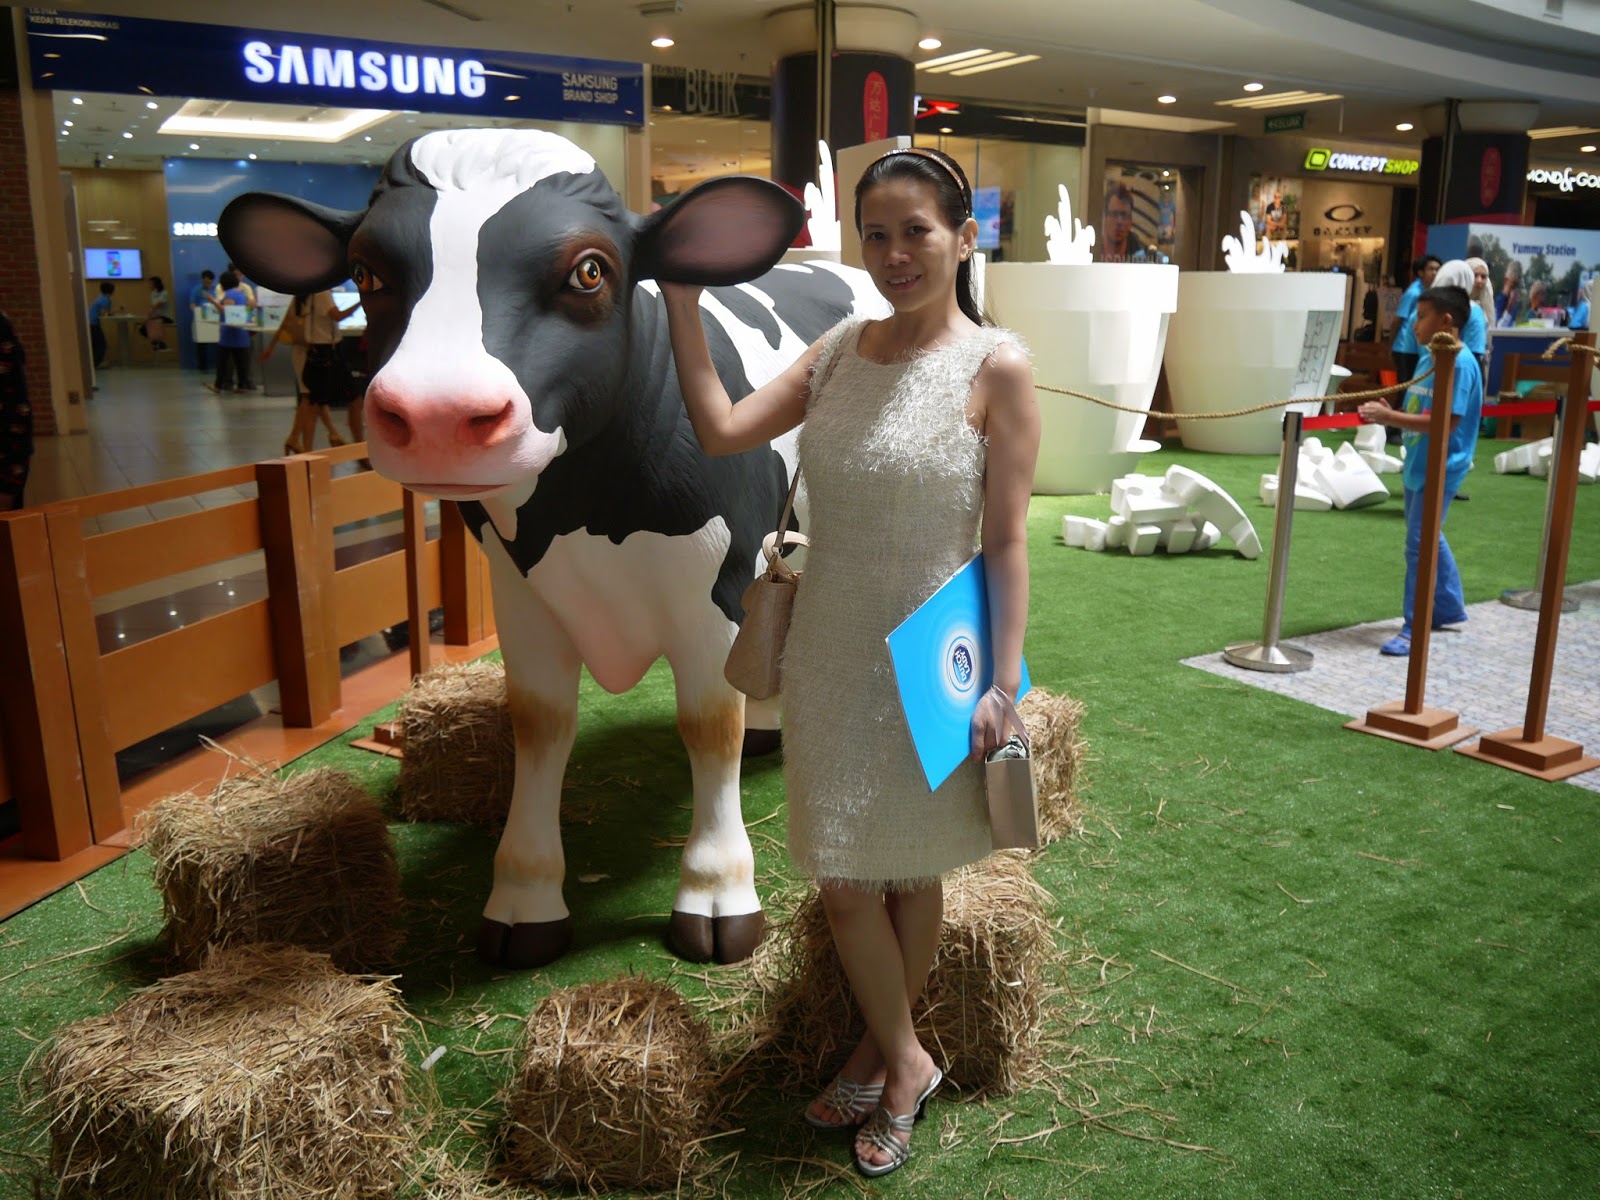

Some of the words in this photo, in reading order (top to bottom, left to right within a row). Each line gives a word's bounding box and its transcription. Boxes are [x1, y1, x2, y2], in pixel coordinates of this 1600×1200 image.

[30, 15, 54, 24] KEDAI
[243, 41, 486, 98] SAMSUNG
[562, 72, 618, 91] SAMSUNG
[563, 88, 593, 103] BRAND
[594, 91, 618, 104] SHOP
[173, 222, 218, 236] SAMS
[1513, 242, 1544, 256] Yummy
[1546, 243, 1577, 256] Station
